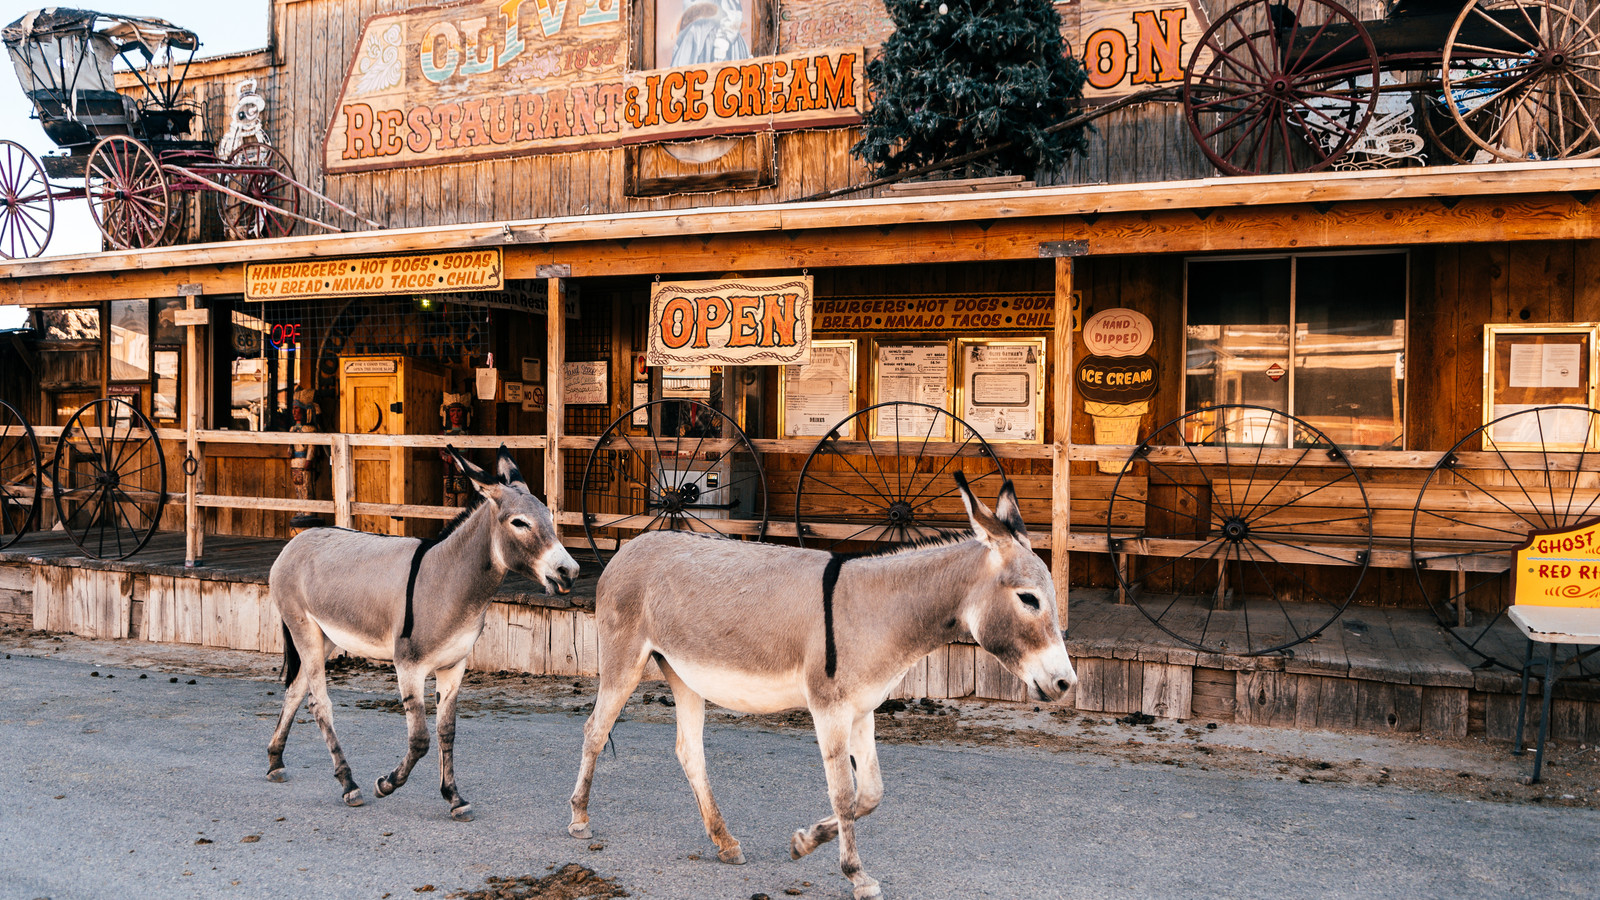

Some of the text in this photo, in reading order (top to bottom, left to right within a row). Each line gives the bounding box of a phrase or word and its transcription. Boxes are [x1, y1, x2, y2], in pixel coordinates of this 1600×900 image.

[563, 43, 620, 71] 1837
[1080, 7, 1187, 90] ON
[342, 83, 623, 160] RESTAURANT
[644, 70, 709, 127] ICE
[711, 53, 857, 118] CREAM
[252, 253, 491, 280] HAMBURGERS HOT DOGS SODAS
[252, 271, 486, 295] FRY BREAD NAVAJO TACOS CHILI
[813, 297, 1055, 314] MBURGERS HOT DOGS SODA
[659, 293, 799, 349] OPEN
[822, 316, 872, 328] BREAD
[884, 314, 945, 328] NAVAJO
[952, 313, 1002, 327] TACOS
[1015, 312, 1055, 326] CHIL
[1102, 320, 1130, 330] HAND
[272, 323, 301, 345] OPE
[1095, 332, 1139, 344] DIPPED
[1081, 368, 1152, 385] ICE CREAM
[1537, 530, 1595, 554] GHOST
[1539, 564, 1600, 579] RED RI
